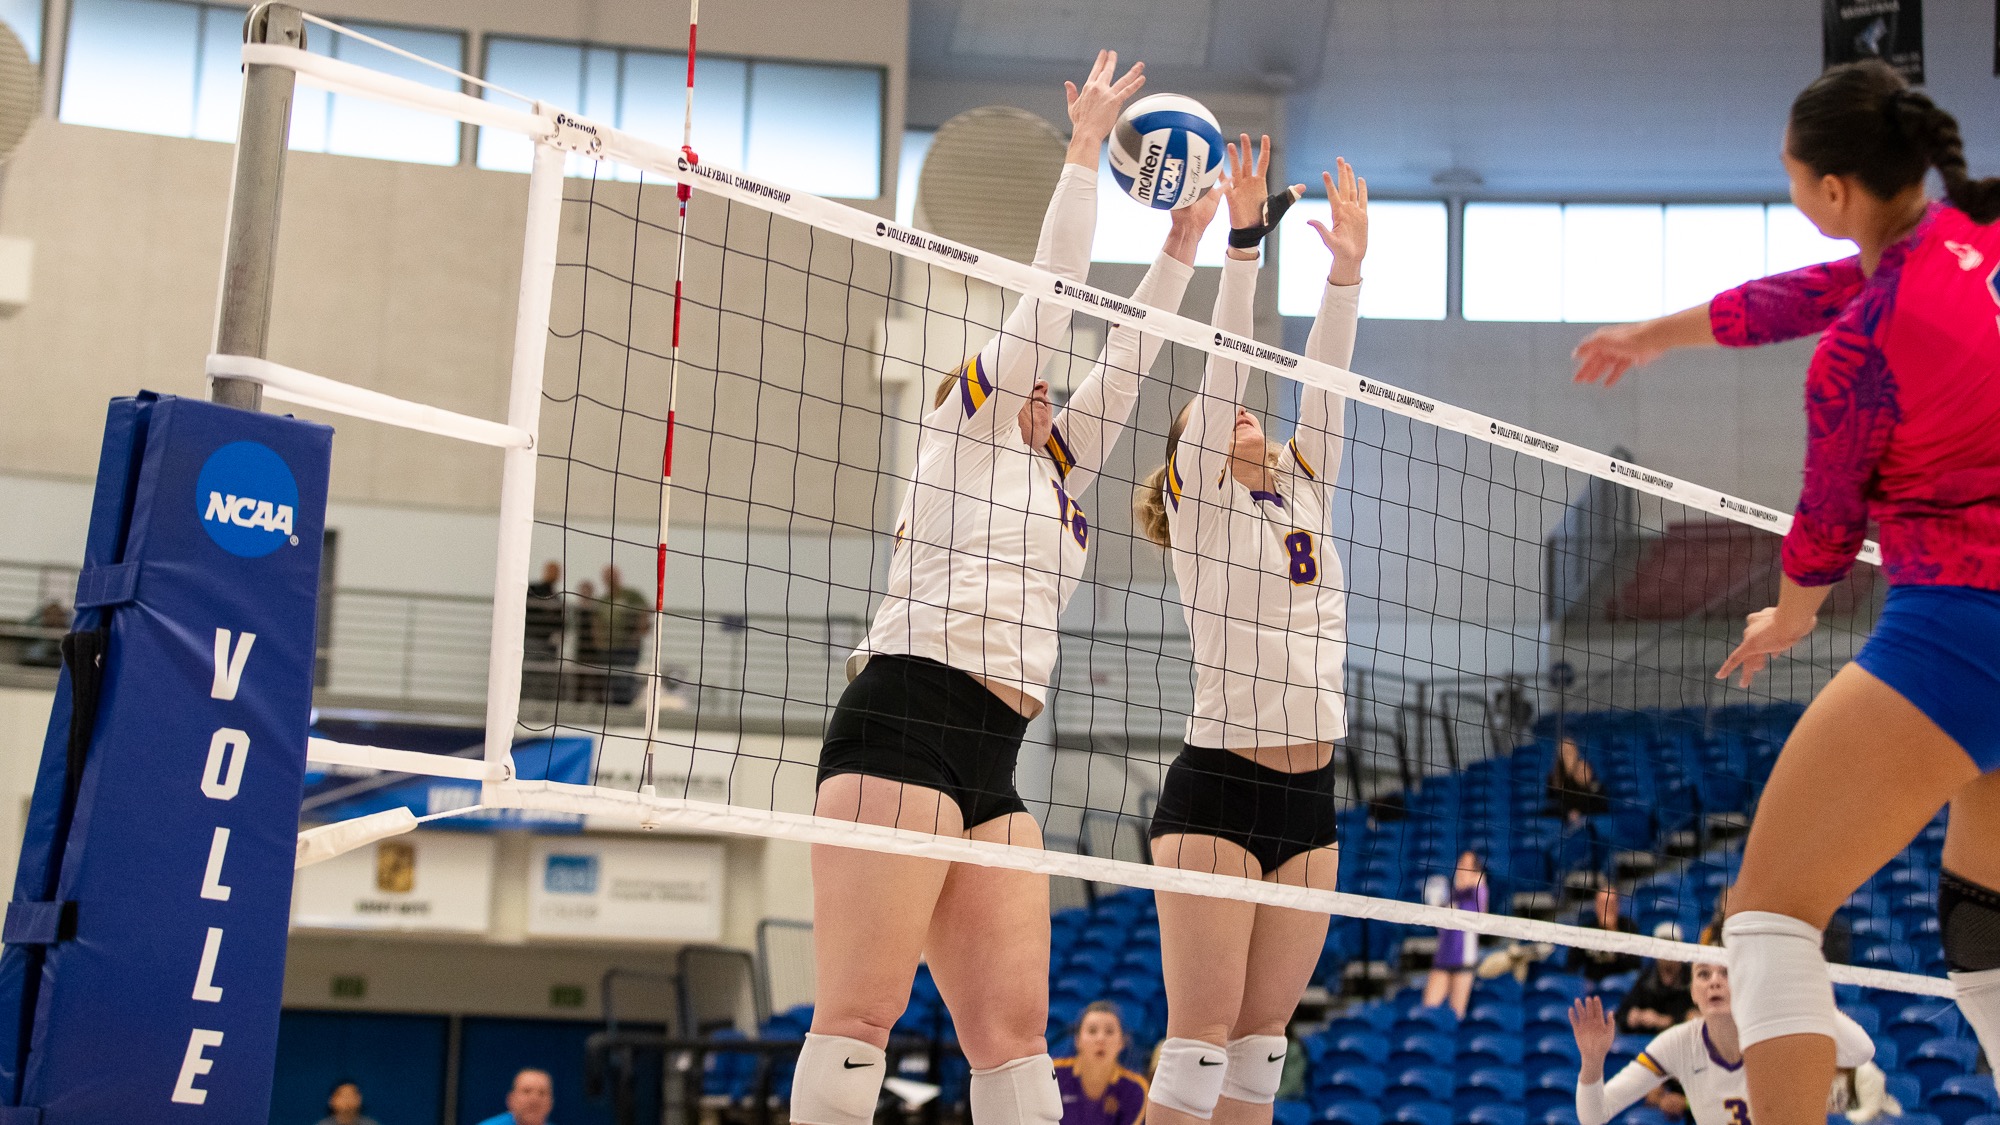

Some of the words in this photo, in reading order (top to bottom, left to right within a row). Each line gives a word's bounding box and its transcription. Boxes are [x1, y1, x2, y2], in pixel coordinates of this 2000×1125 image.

[567, 118, 597, 136] Senoh
[690, 162, 733, 186] VOLLEYBALL
[735, 176, 791, 204] CHAMPIONSHIP
[1138, 144, 1163, 201] molten
[1157, 158, 1182, 203] NCAA
[887, 226, 926, 249] VOLLEYBALL
[928, 240, 979, 265] CHAMPIONSHIP
[1063, 284, 1099, 306] VOLLEYBALL
[1100, 297, 1147, 320] CHAMPIONSHIP
[1223, 336, 1255, 357] VOLLEYBALL
[1255, 347, 1298, 369] CHAMPIONSHIP
[1366, 383, 1396, 402] VOLLEYBALL
[1396, 393, 1435, 414] CHAMPIONSHIP
[1497, 425, 1523, 442] VOLLEYBALL
[1523, 434, 1560, 453] CHAMPIONSHIP
[1616, 464, 1642, 480] VOLLEYBALL
[1642, 473, 1674, 490] CHAMPIONSHIP
[204, 491, 293, 535] NCAA
[1726, 500, 1749, 515] VOLLEYBALL
[1749, 507, 1778, 523] CHAMPIONSHIP
[1284, 530, 1318, 586] 8
[172, 628, 256, 1106] VOLLE
[1723, 1098, 1751, 1125] 3
